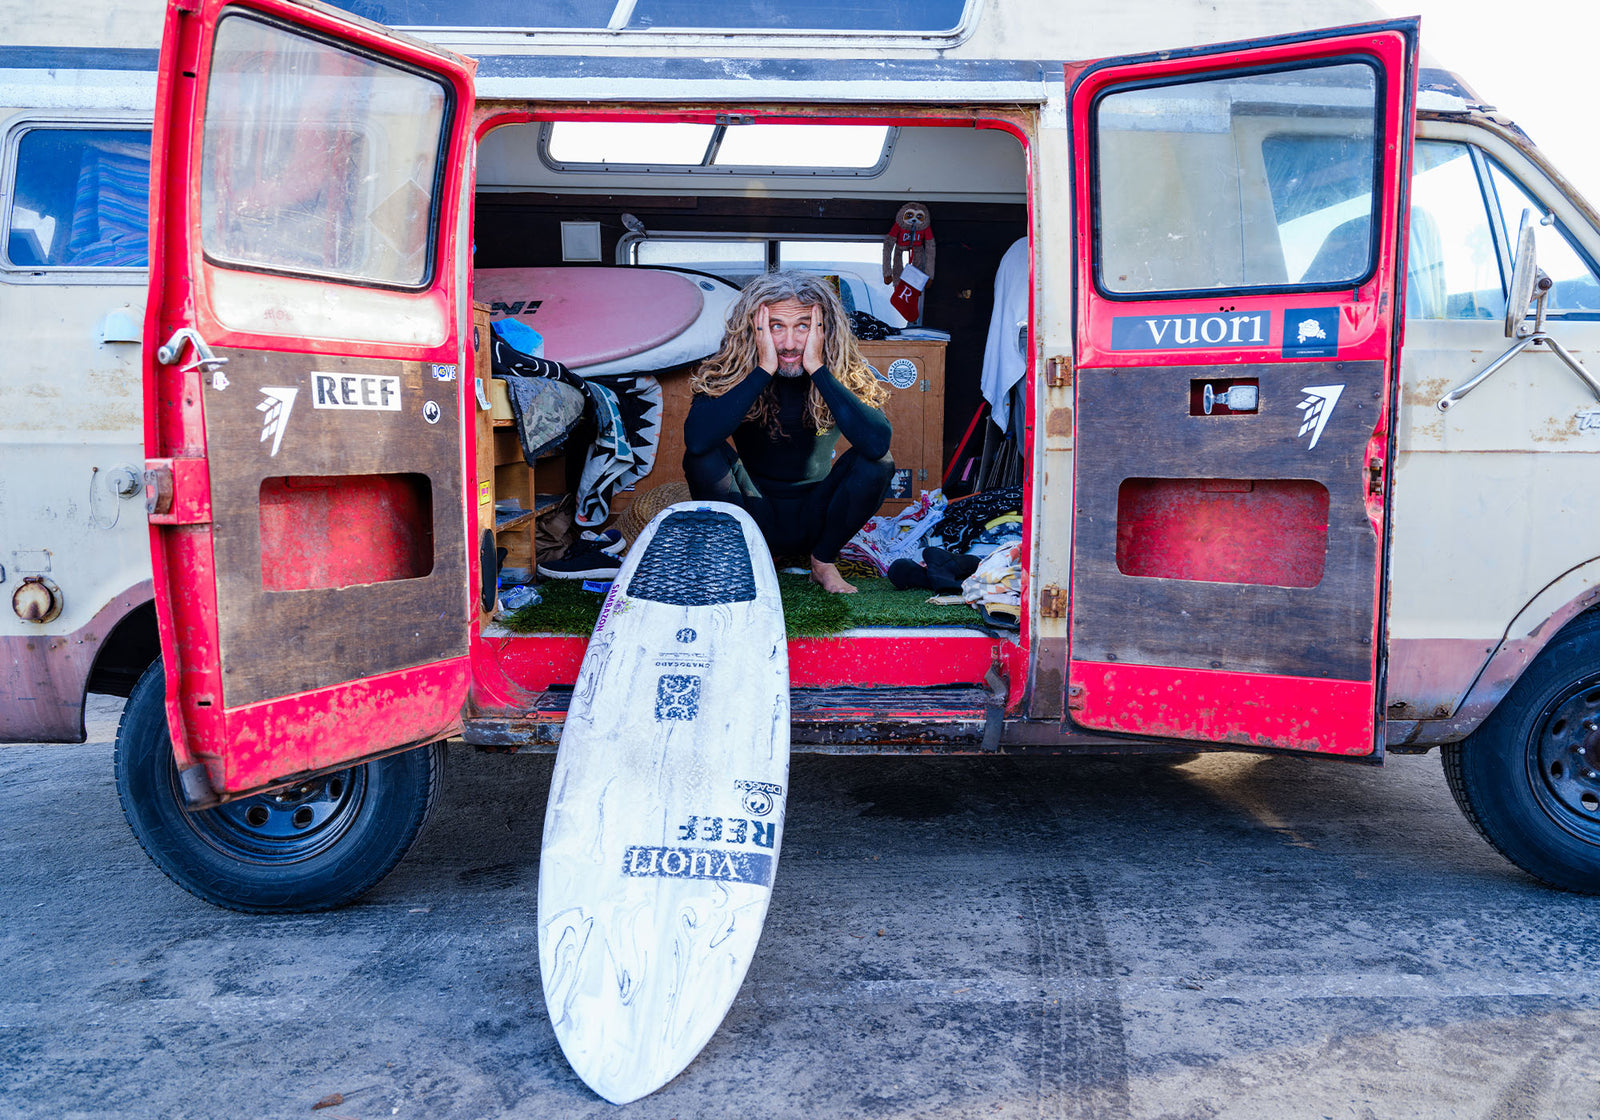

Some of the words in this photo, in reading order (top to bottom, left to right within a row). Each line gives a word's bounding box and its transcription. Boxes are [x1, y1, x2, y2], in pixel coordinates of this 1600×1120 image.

[898, 286, 913, 305] R
[1145, 315, 1265, 345] vuori
[316, 375, 396, 408] REEF
[595, 584, 620, 633] SAMBAZON
[735, 780, 782, 796] DRAGON
[677, 815, 776, 849] REEF
[629, 848, 742, 879] vuori
